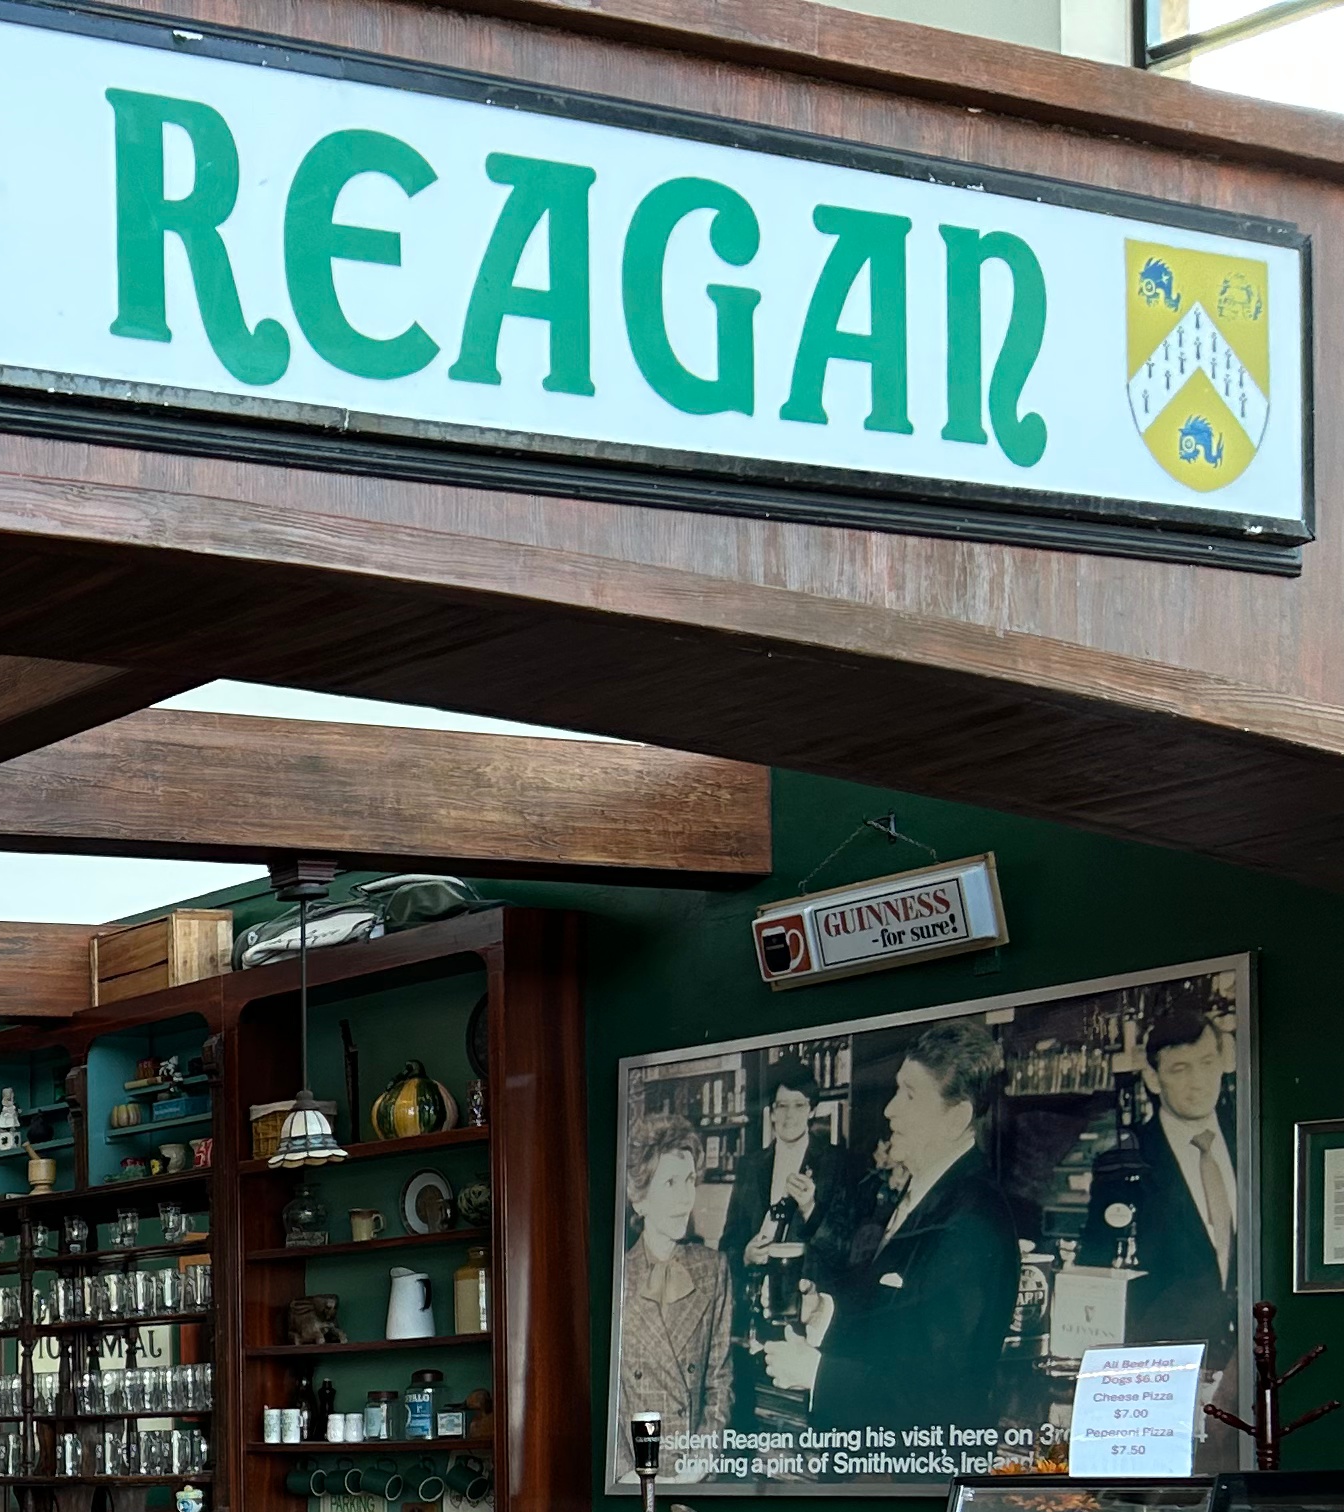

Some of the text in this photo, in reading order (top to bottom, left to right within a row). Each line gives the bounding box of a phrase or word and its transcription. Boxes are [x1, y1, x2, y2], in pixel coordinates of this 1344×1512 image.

[103, 87, 1050, 470] REAGAN
[823, 888, 952, 938] GUINNESS
[911, 913, 959, 943] sure!
[1016, 1291, 1044, 1306] ARP
[1122, 1359, 1150, 1369] Beef
[1152, 1358, 1175, 1369] Hot
[1101, 1373, 1170, 1386] Dogs $6.00
[1093, 1390, 1174, 1403] Cheese Pizza
[1113, 1408, 1149, 1419] $7.00
[659, 1430, 719, 1450] esident
[723, 1429, 793, 1453] Reagan
[798, 1427, 862, 1453] during
[865, 1426, 896, 1448] his
[901, 1425, 944, 1447] visit
[949, 1424, 999, 1446] here
[1004, 1428, 1033, 1446] on
[1142, 1426, 1174, 1437] Pizza
[1111, 1444, 1146, 1455] $7.50
[674, 1453, 748, 1478] drinking
[751, 1457, 762, 1473] a
[766, 1453, 804, 1478] pint
[808, 1452, 829, 1473] of
[330, 1494, 376, 1512] PARKING
